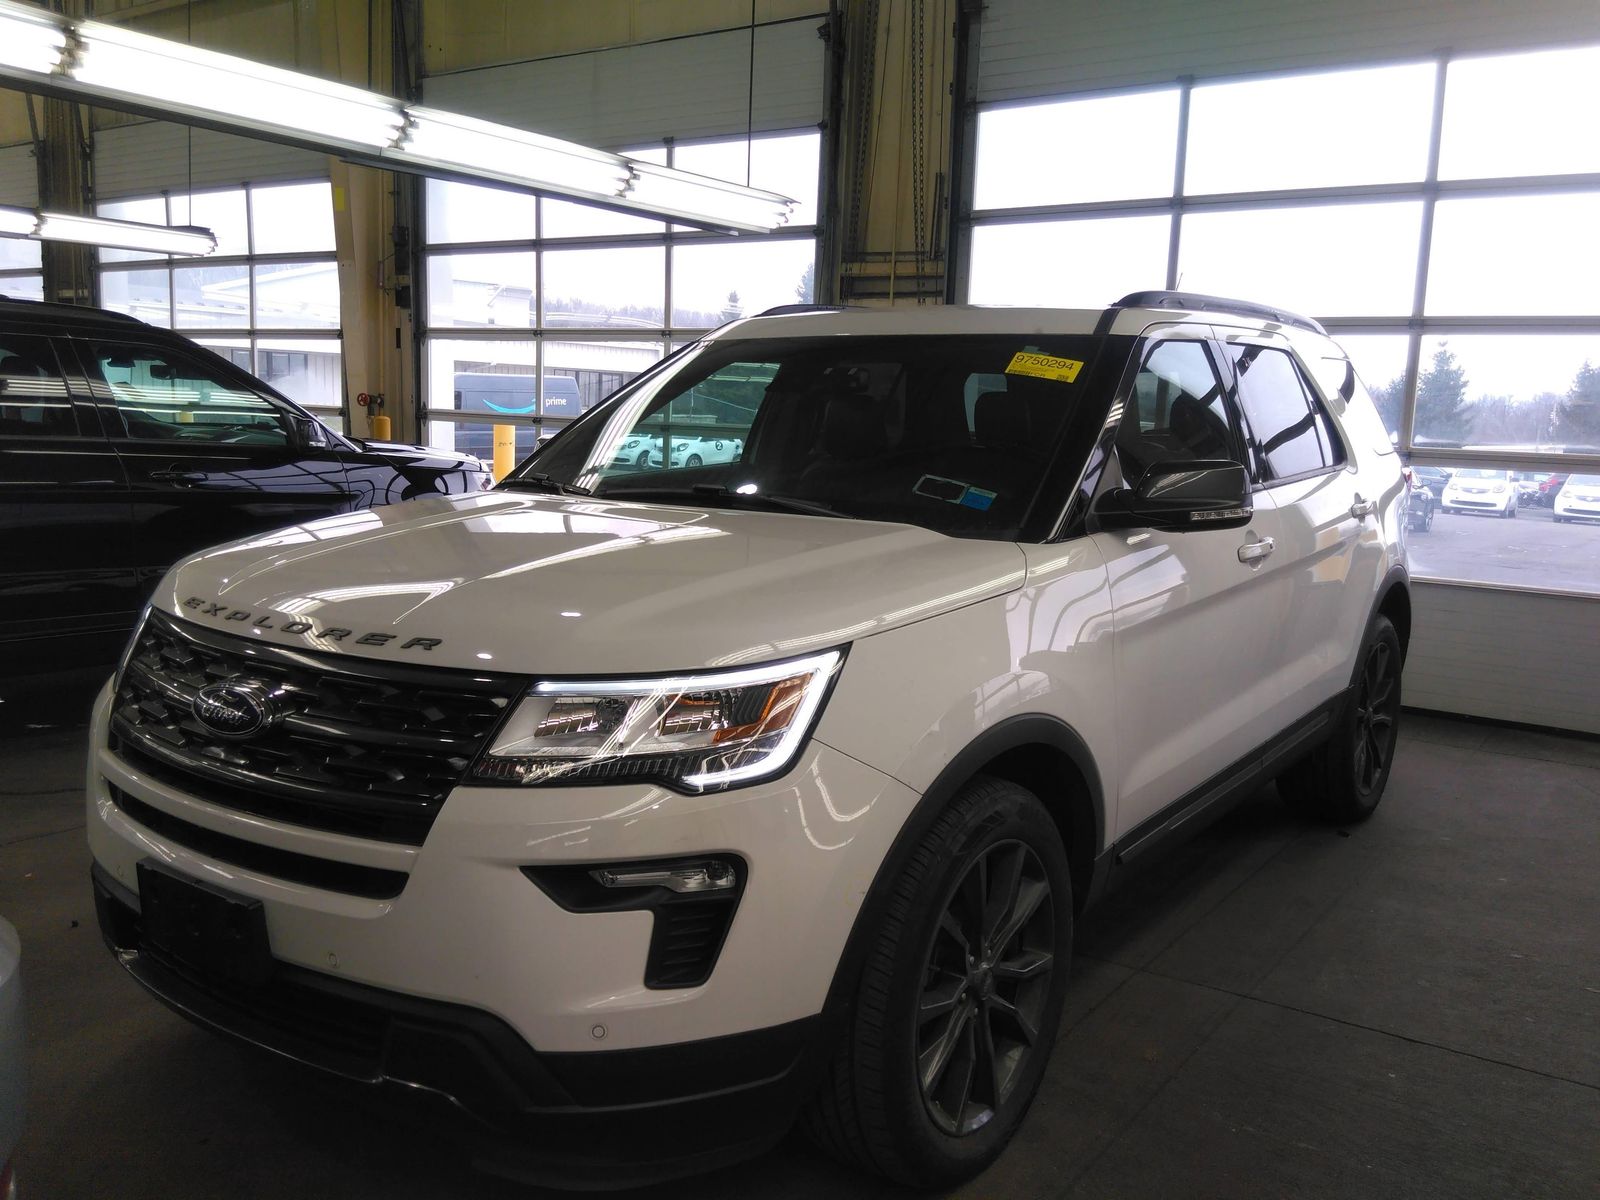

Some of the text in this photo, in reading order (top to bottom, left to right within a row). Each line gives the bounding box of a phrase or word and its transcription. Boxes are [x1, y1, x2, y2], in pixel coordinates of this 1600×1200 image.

[1015, 354, 1074, 370] 9750294
[545, 396, 567, 408] prime
[183, 596, 443, 650] EXPLORER
